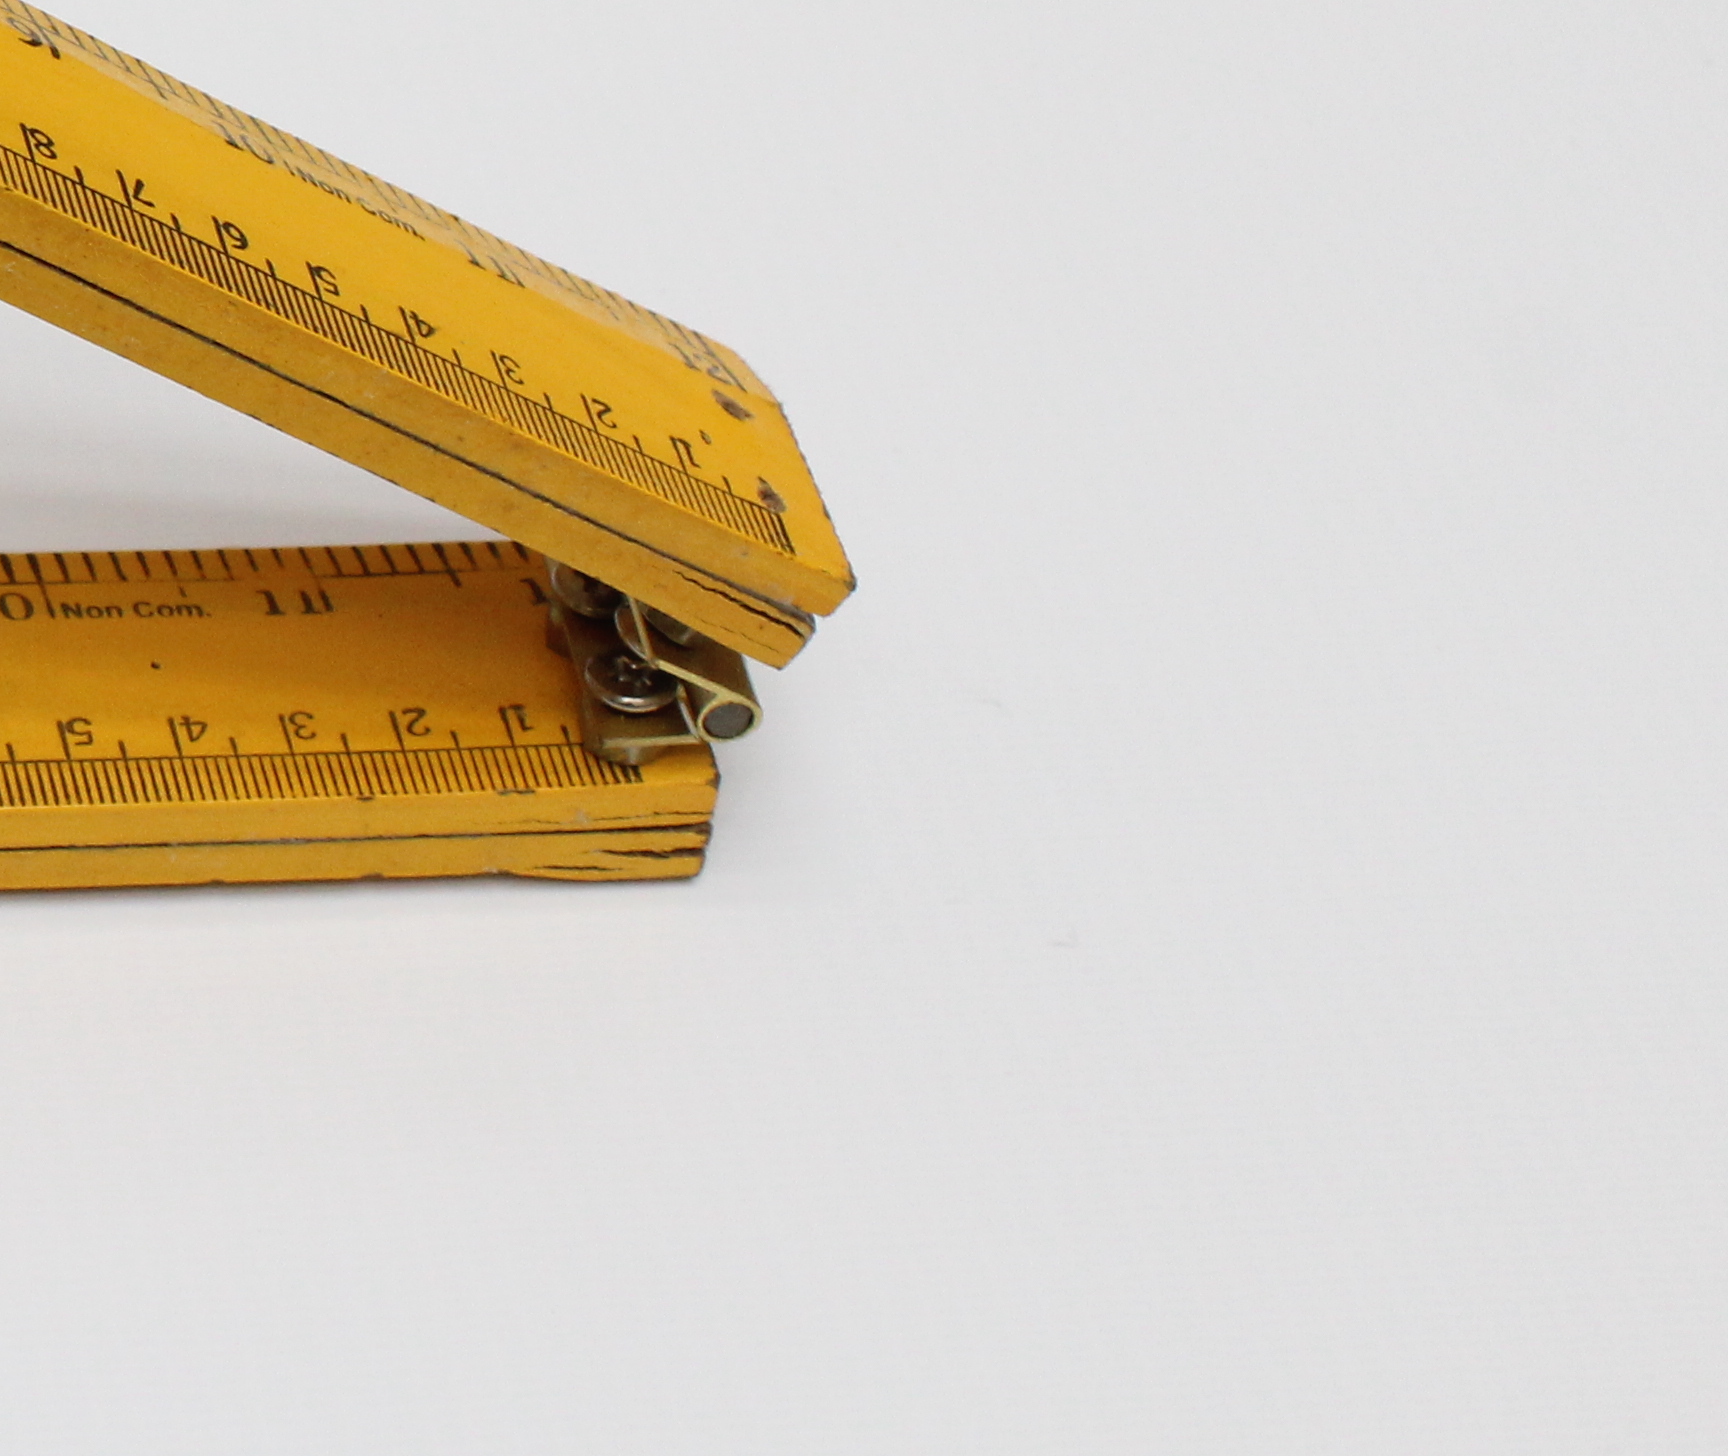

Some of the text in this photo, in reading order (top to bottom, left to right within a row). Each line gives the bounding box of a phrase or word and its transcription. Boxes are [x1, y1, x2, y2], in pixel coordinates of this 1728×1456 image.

[60, 601, 125, 619] Non
[132, 601, 213, 619] Com.
[69, 716, 95, 747] 5
[176, 713, 207, 743] 4
[287, 711, 317, 740] 3
[402, 708, 431, 737] 2
